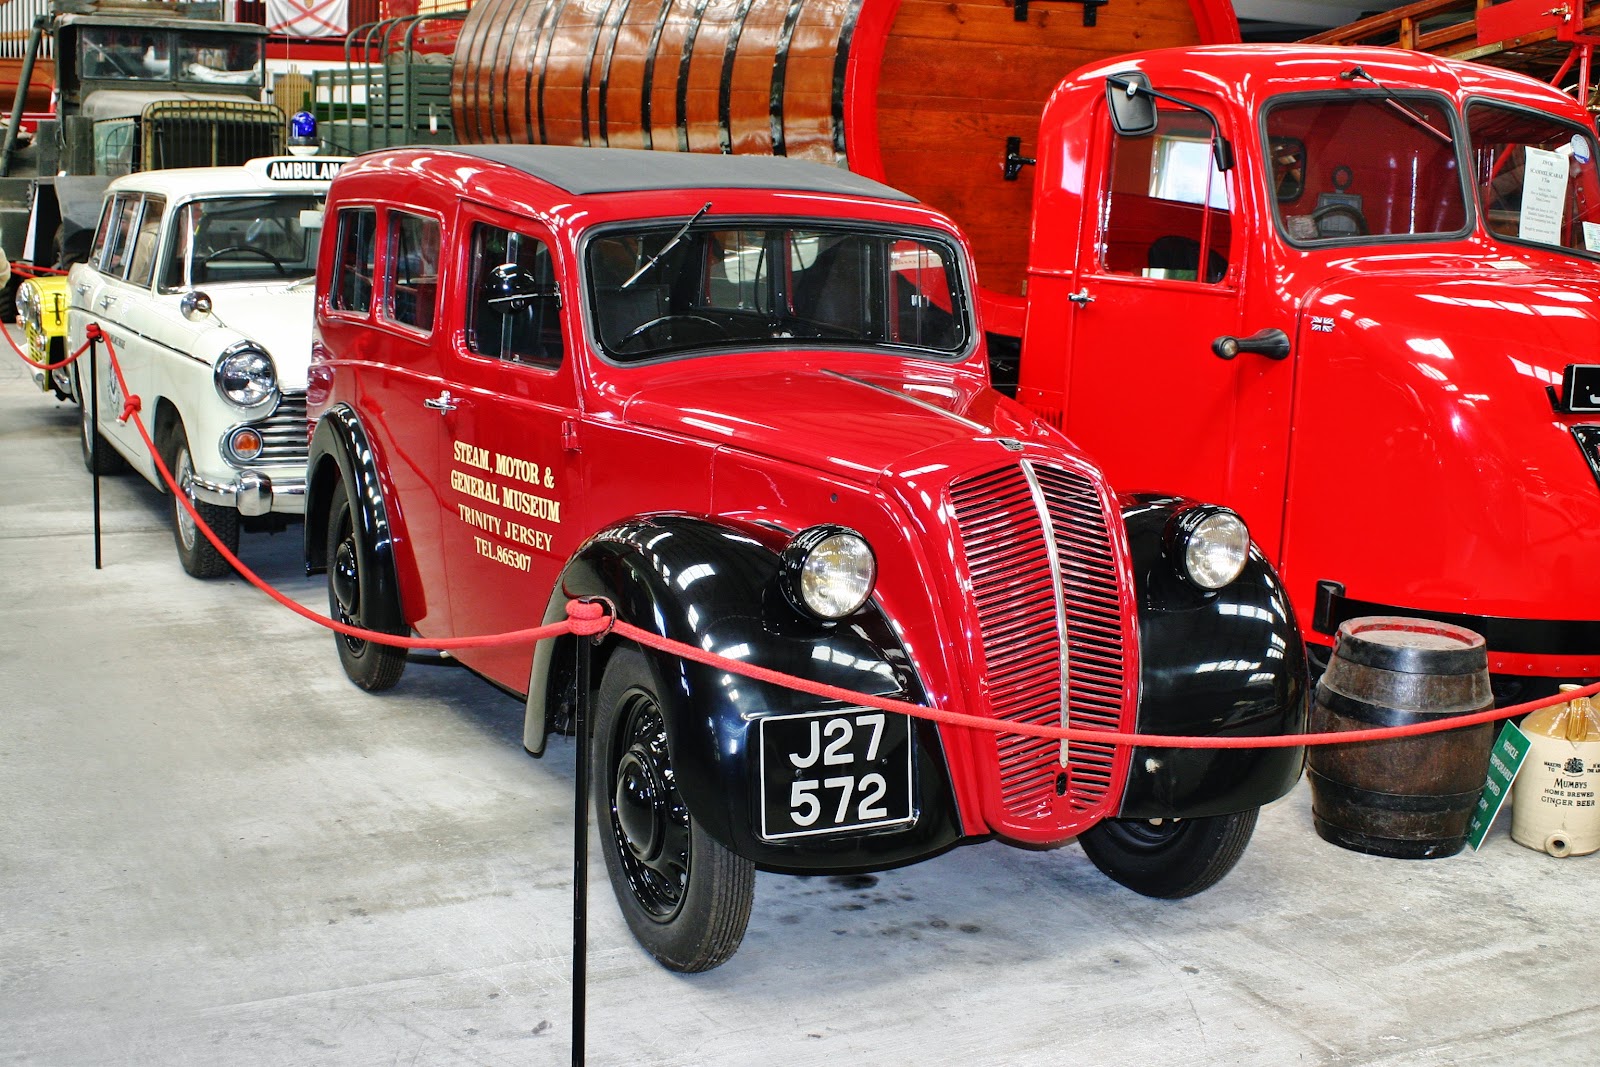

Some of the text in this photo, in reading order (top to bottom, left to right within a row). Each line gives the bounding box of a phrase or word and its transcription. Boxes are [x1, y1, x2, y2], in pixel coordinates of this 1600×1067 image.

[270, 162, 340, 180] AMBULAN
[454, 440, 555, 489] STEAM, MOTOR &
[451, 469, 560, 523] GENERAL MUSEUM
[458, 503, 553, 552] TRINITY JERSEY
[474, 535, 532, 573] TEL.865307
[788, 713, 885, 768] J27
[1503, 740, 1519, 759] VEHICLE
[1490, 753, 1513, 781] TEMPORARILY
[789, 772, 888, 827] 572
[1541, 796, 1573, 806] GINGER
[1544, 788, 1565, 796] HOME
